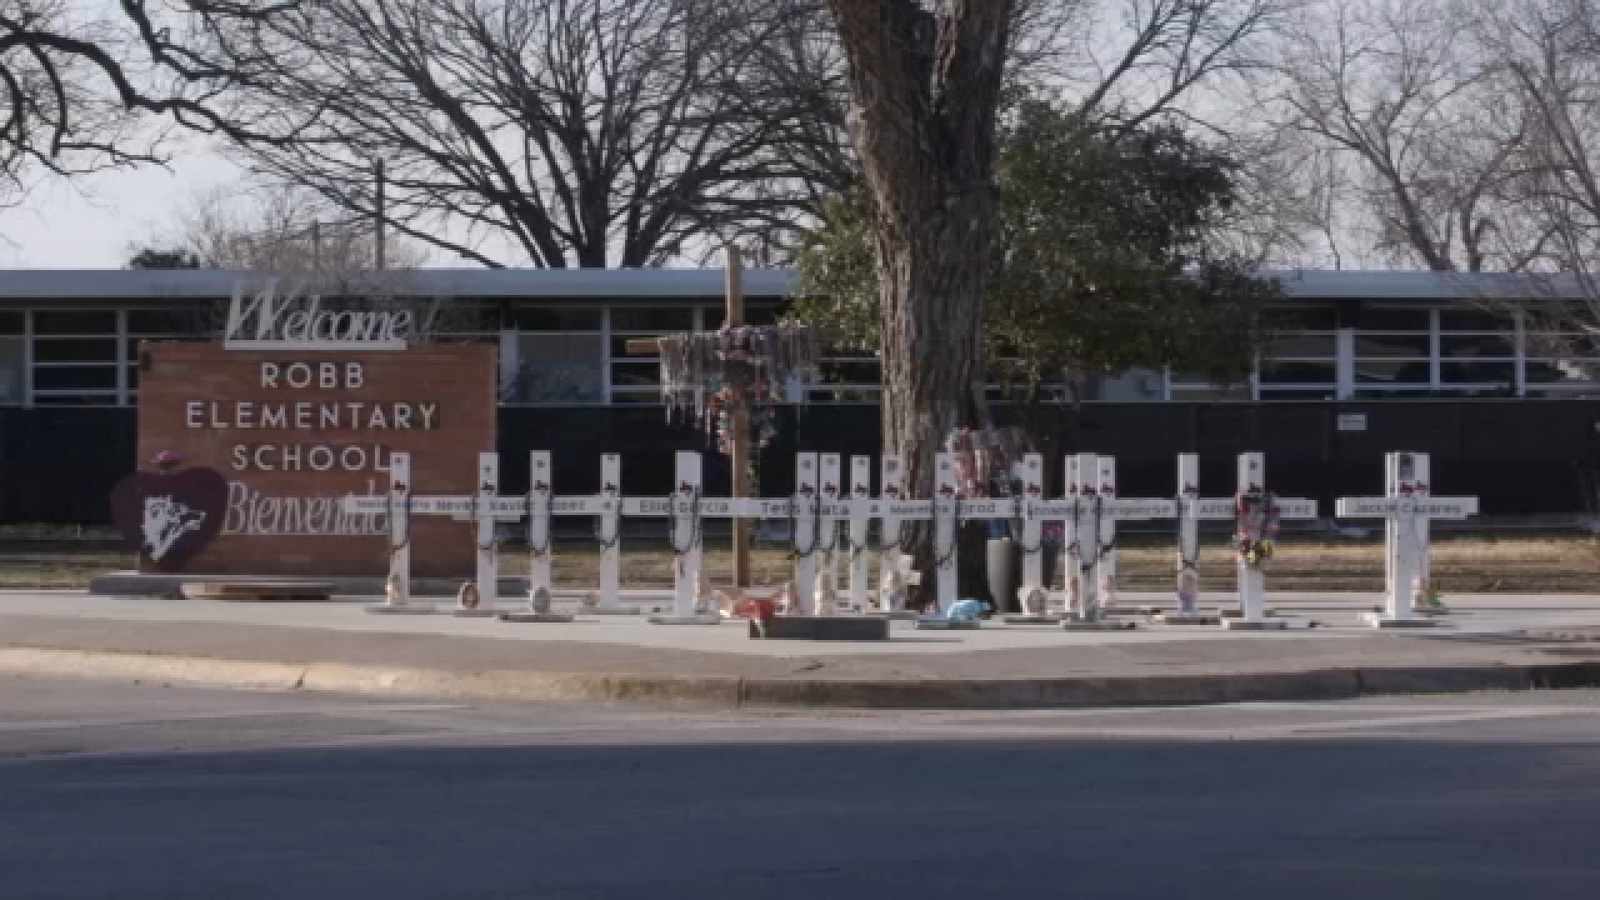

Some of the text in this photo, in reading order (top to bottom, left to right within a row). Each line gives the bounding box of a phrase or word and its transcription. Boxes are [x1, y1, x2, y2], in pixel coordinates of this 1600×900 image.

[225, 278, 413, 341] Welcome
[260, 362, 364, 389] ROBB
[185, 402, 437, 429] ELEMENTARY
[231, 445, 392, 471] SCHOOL
